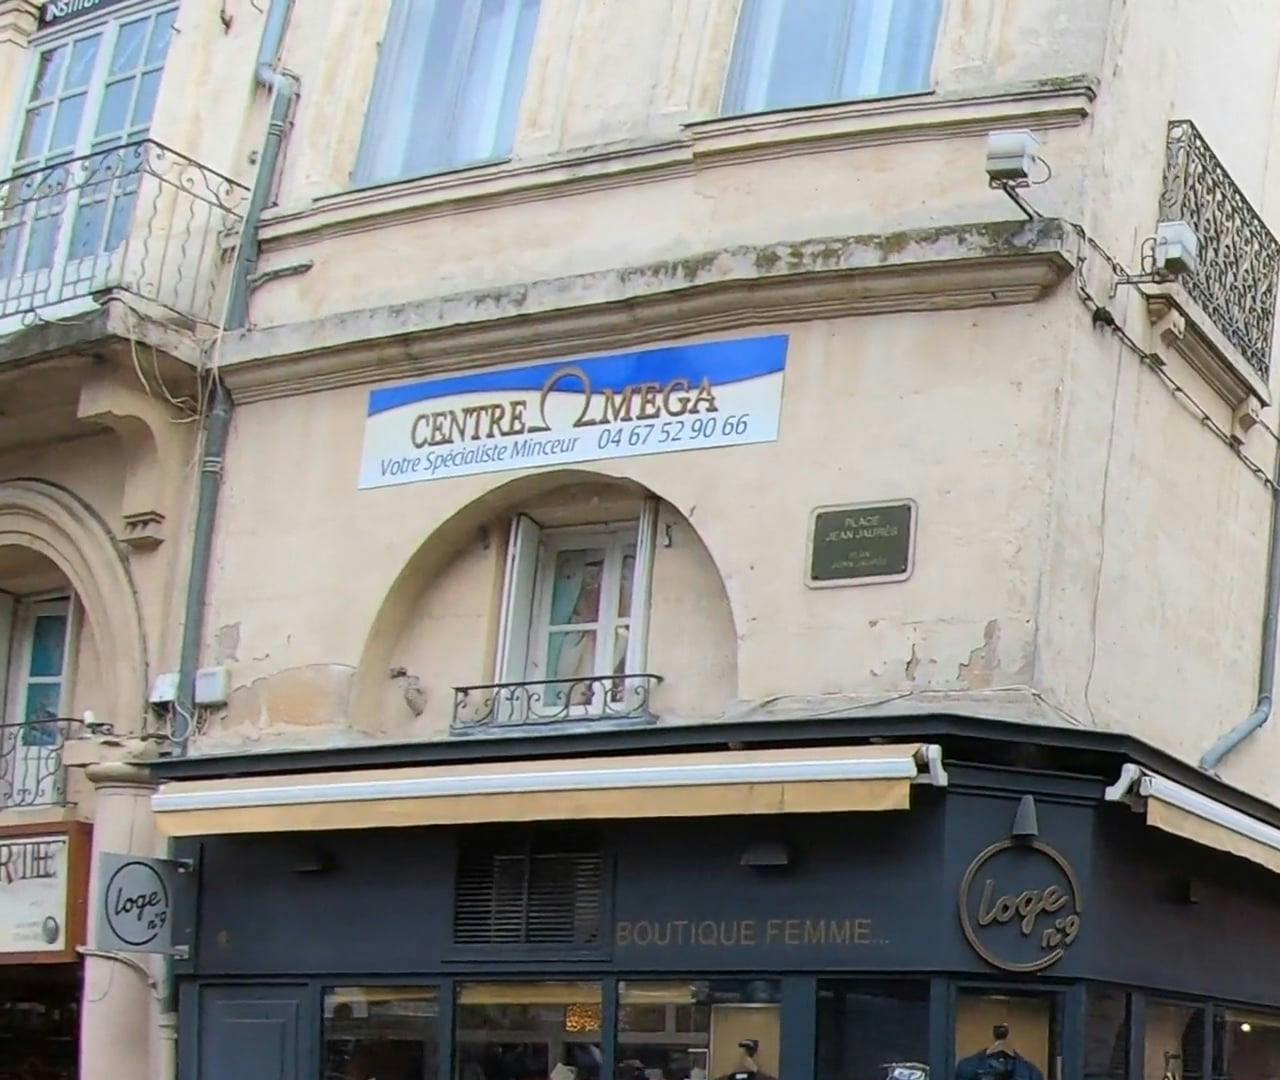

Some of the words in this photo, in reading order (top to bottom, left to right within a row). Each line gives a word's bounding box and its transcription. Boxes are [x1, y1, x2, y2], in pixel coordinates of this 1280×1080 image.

[381, 456, 421, 477] Votre
[423, 443, 508, 475] Spécialiste
[509, 436, 581, 459] Minceur
[597, 428, 623, 450] 04
[627, 424, 655, 446] 67
[657, 420, 686, 443] 52
[689, 416, 717, 440] 90
[721, 413, 750, 437] 66
[411, 399, 528, 450] CENTRE
[114, 887, 163, 921] loge
[978, 879, 1070, 935] loge
[615, 920, 757, 946] BOUTIQUE
